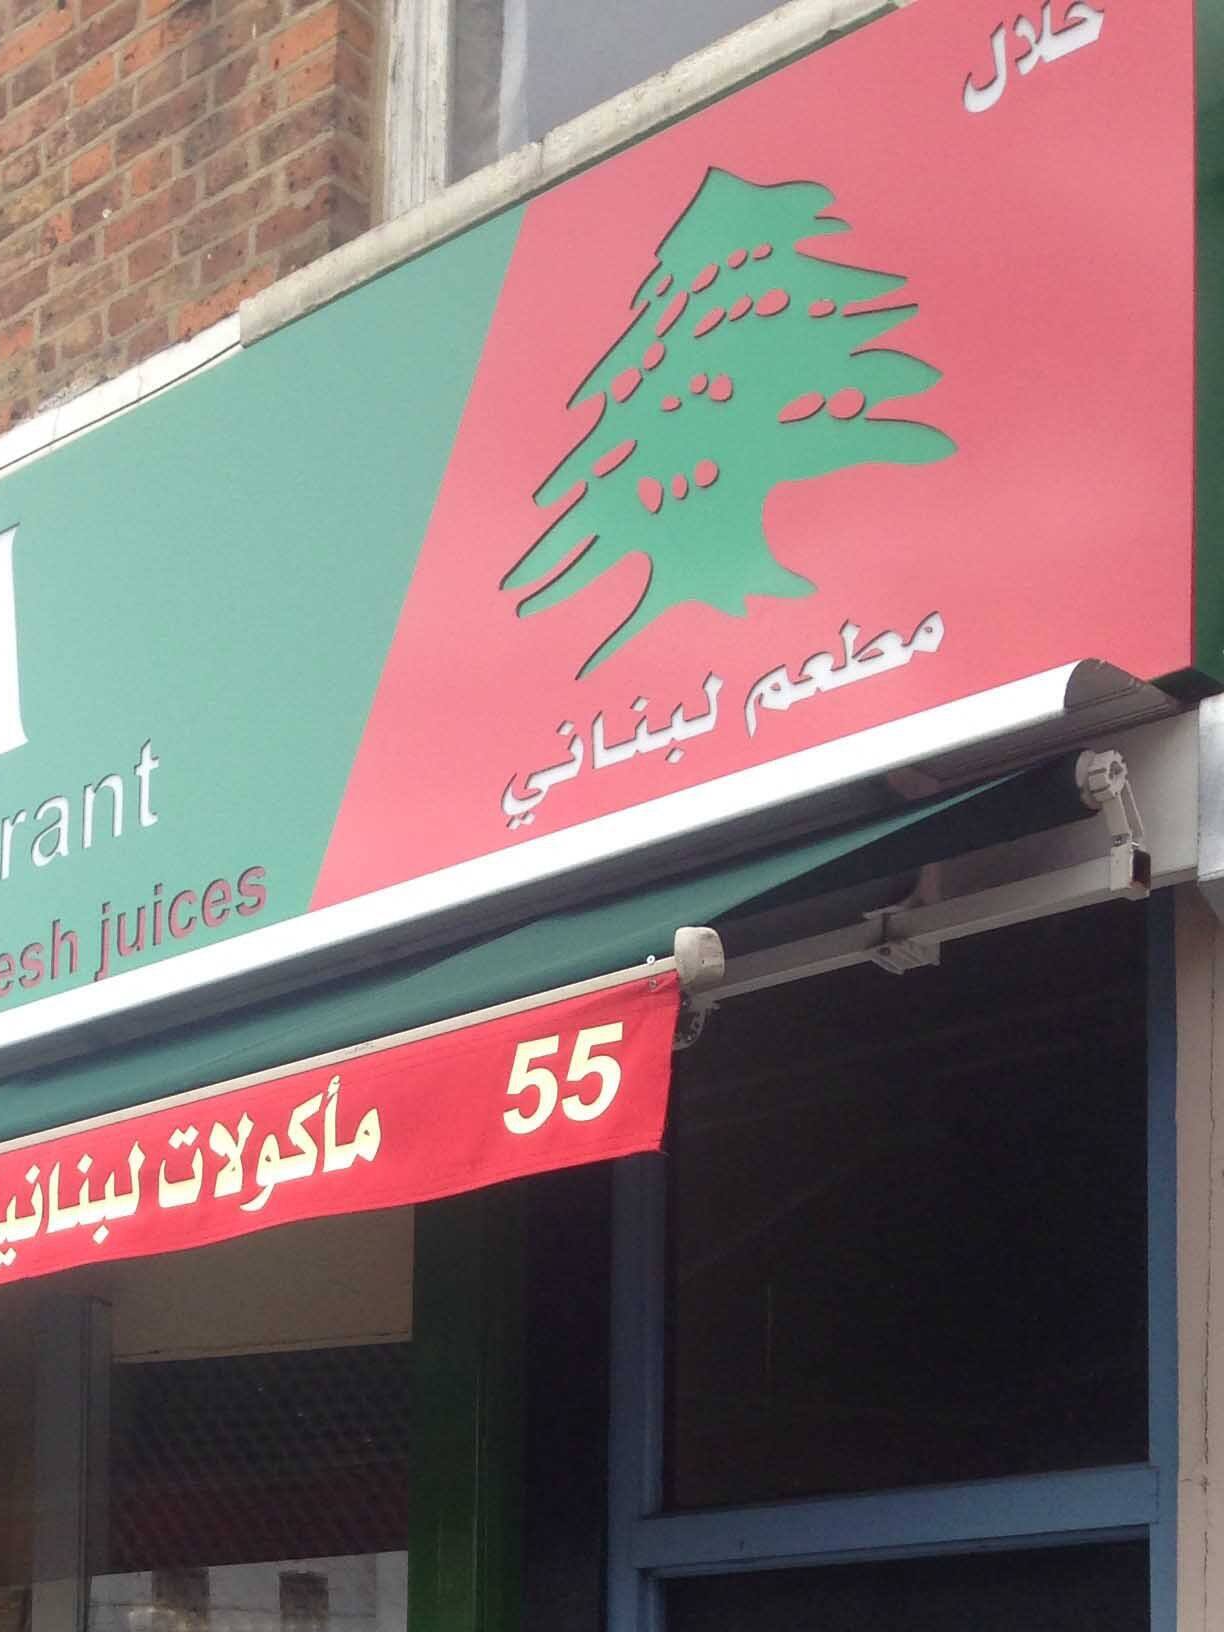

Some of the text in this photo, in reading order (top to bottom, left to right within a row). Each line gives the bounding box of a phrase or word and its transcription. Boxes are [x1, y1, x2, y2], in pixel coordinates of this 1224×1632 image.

[961, 0, 1105, 114] حلال
[499, 610, 945, 831] مطعم لبناني
[93, 863, 268, 983] juices
[501, 1020, 625, 1136] 55
